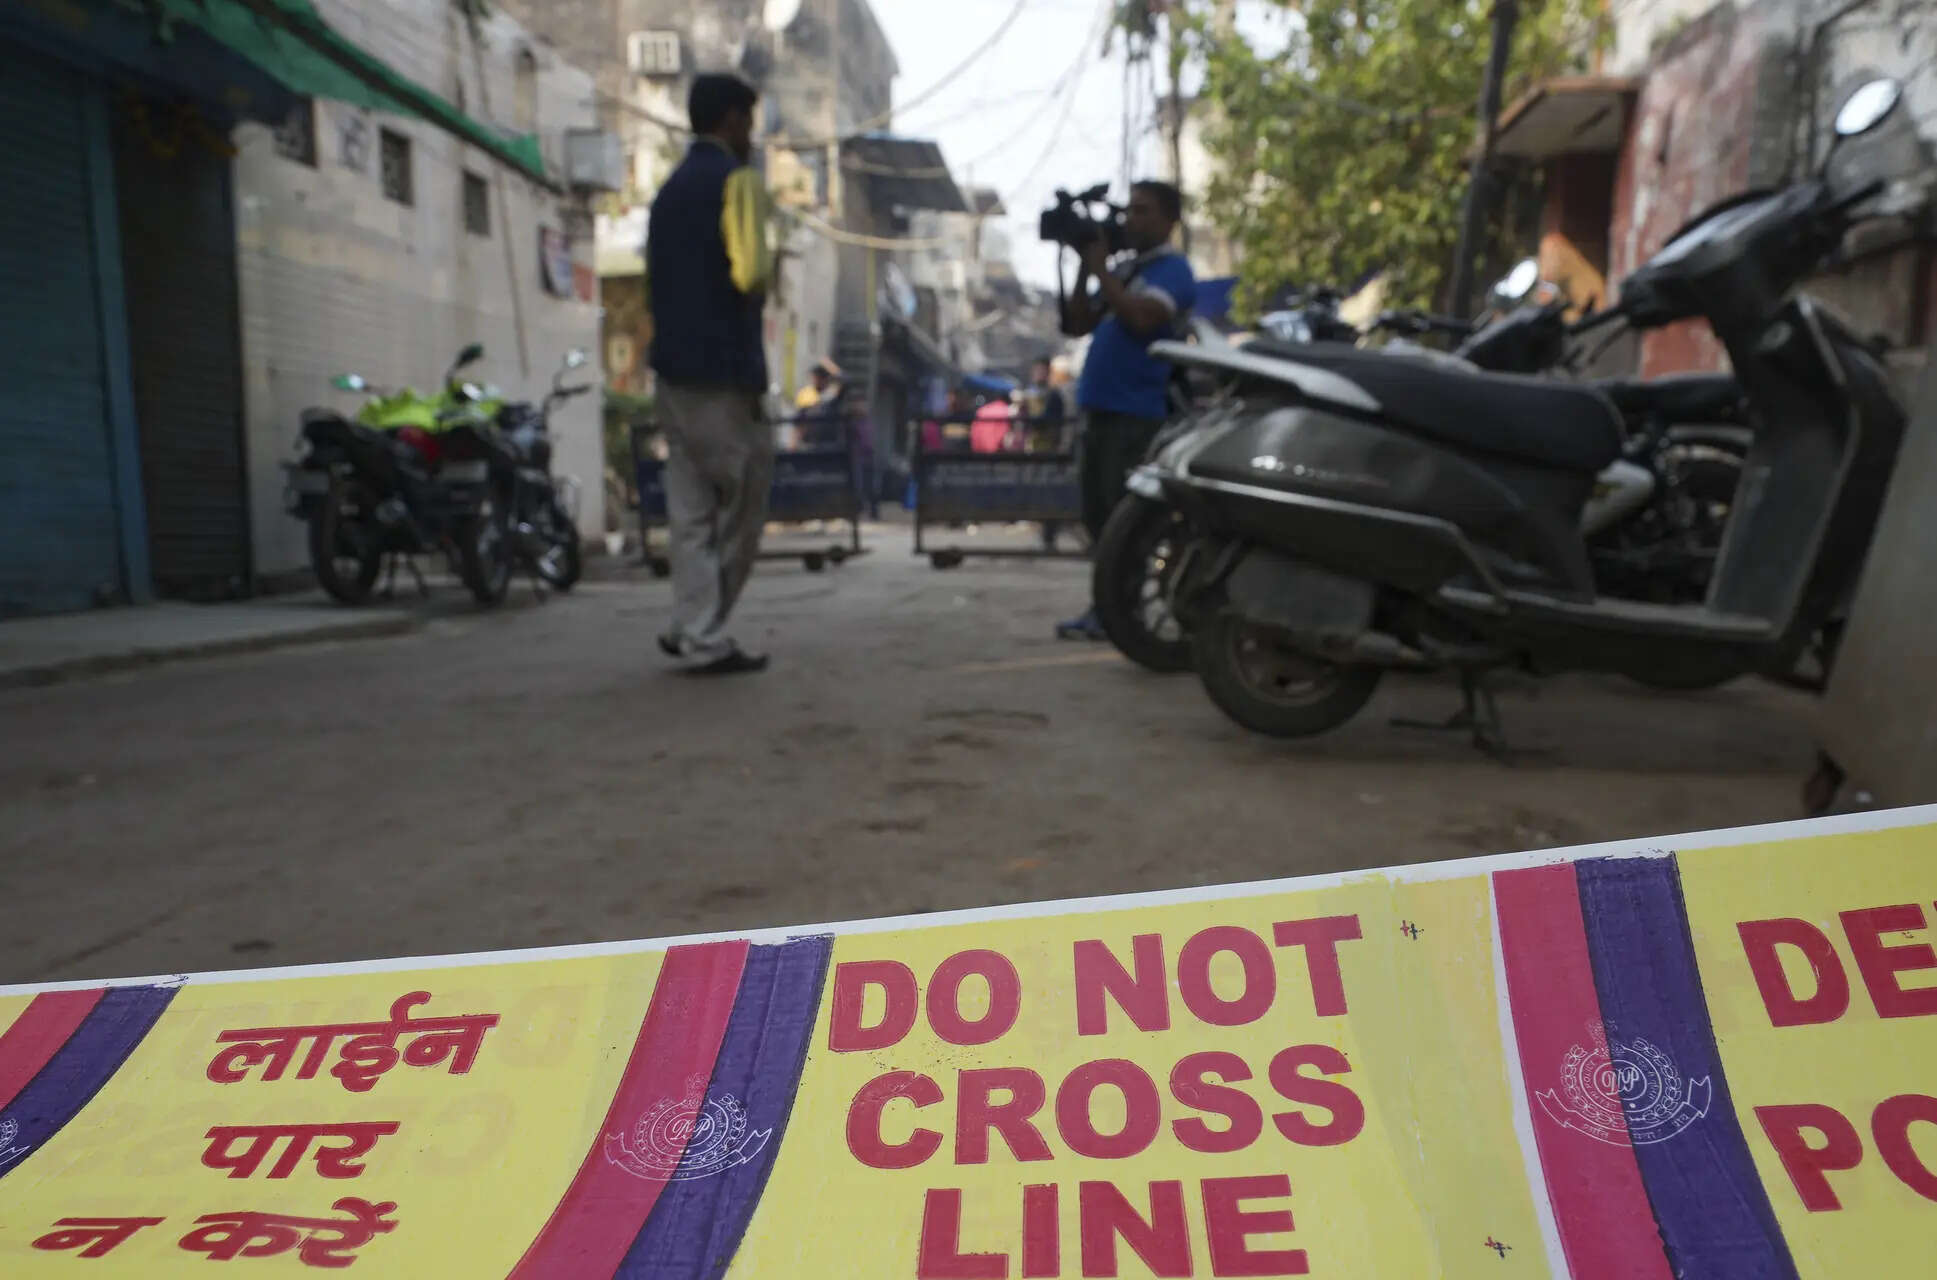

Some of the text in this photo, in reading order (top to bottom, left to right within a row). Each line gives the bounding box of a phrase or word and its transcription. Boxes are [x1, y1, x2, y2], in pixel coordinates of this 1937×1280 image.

[828, 914, 1362, 1053] DO NOT
[1736, 900, 1937, 1028] DE
[206, 991, 501, 1093] लाईन
[201, 1121, 400, 1179] पार
[846, 1044, 1365, 1170] CROSS
[32, 1196, 400, 1268] न करें
[916, 1173, 1310, 1280] LINE
